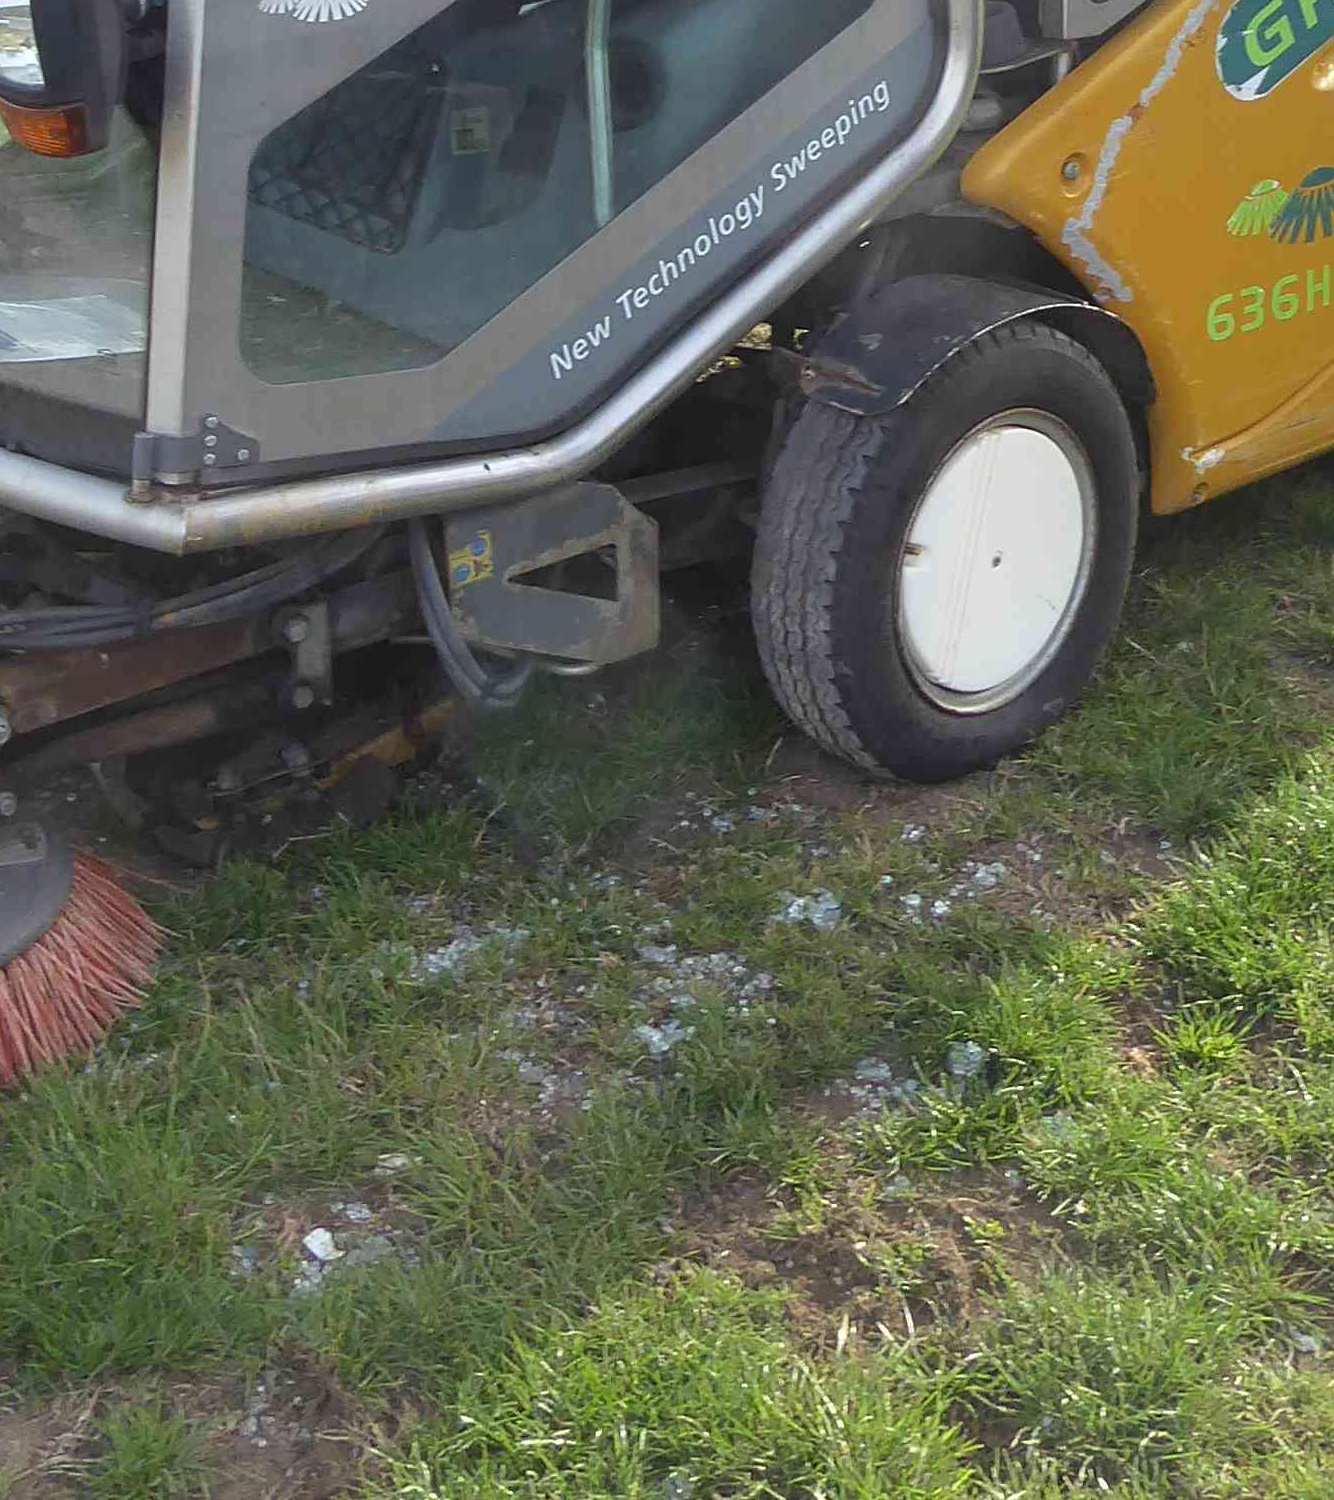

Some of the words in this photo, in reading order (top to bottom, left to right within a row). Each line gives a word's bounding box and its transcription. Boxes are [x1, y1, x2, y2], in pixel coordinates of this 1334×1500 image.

[548, 315, 612, 380] New
[615, 184, 765, 319] Technology
[769, 79, 891, 192] Sweeping
